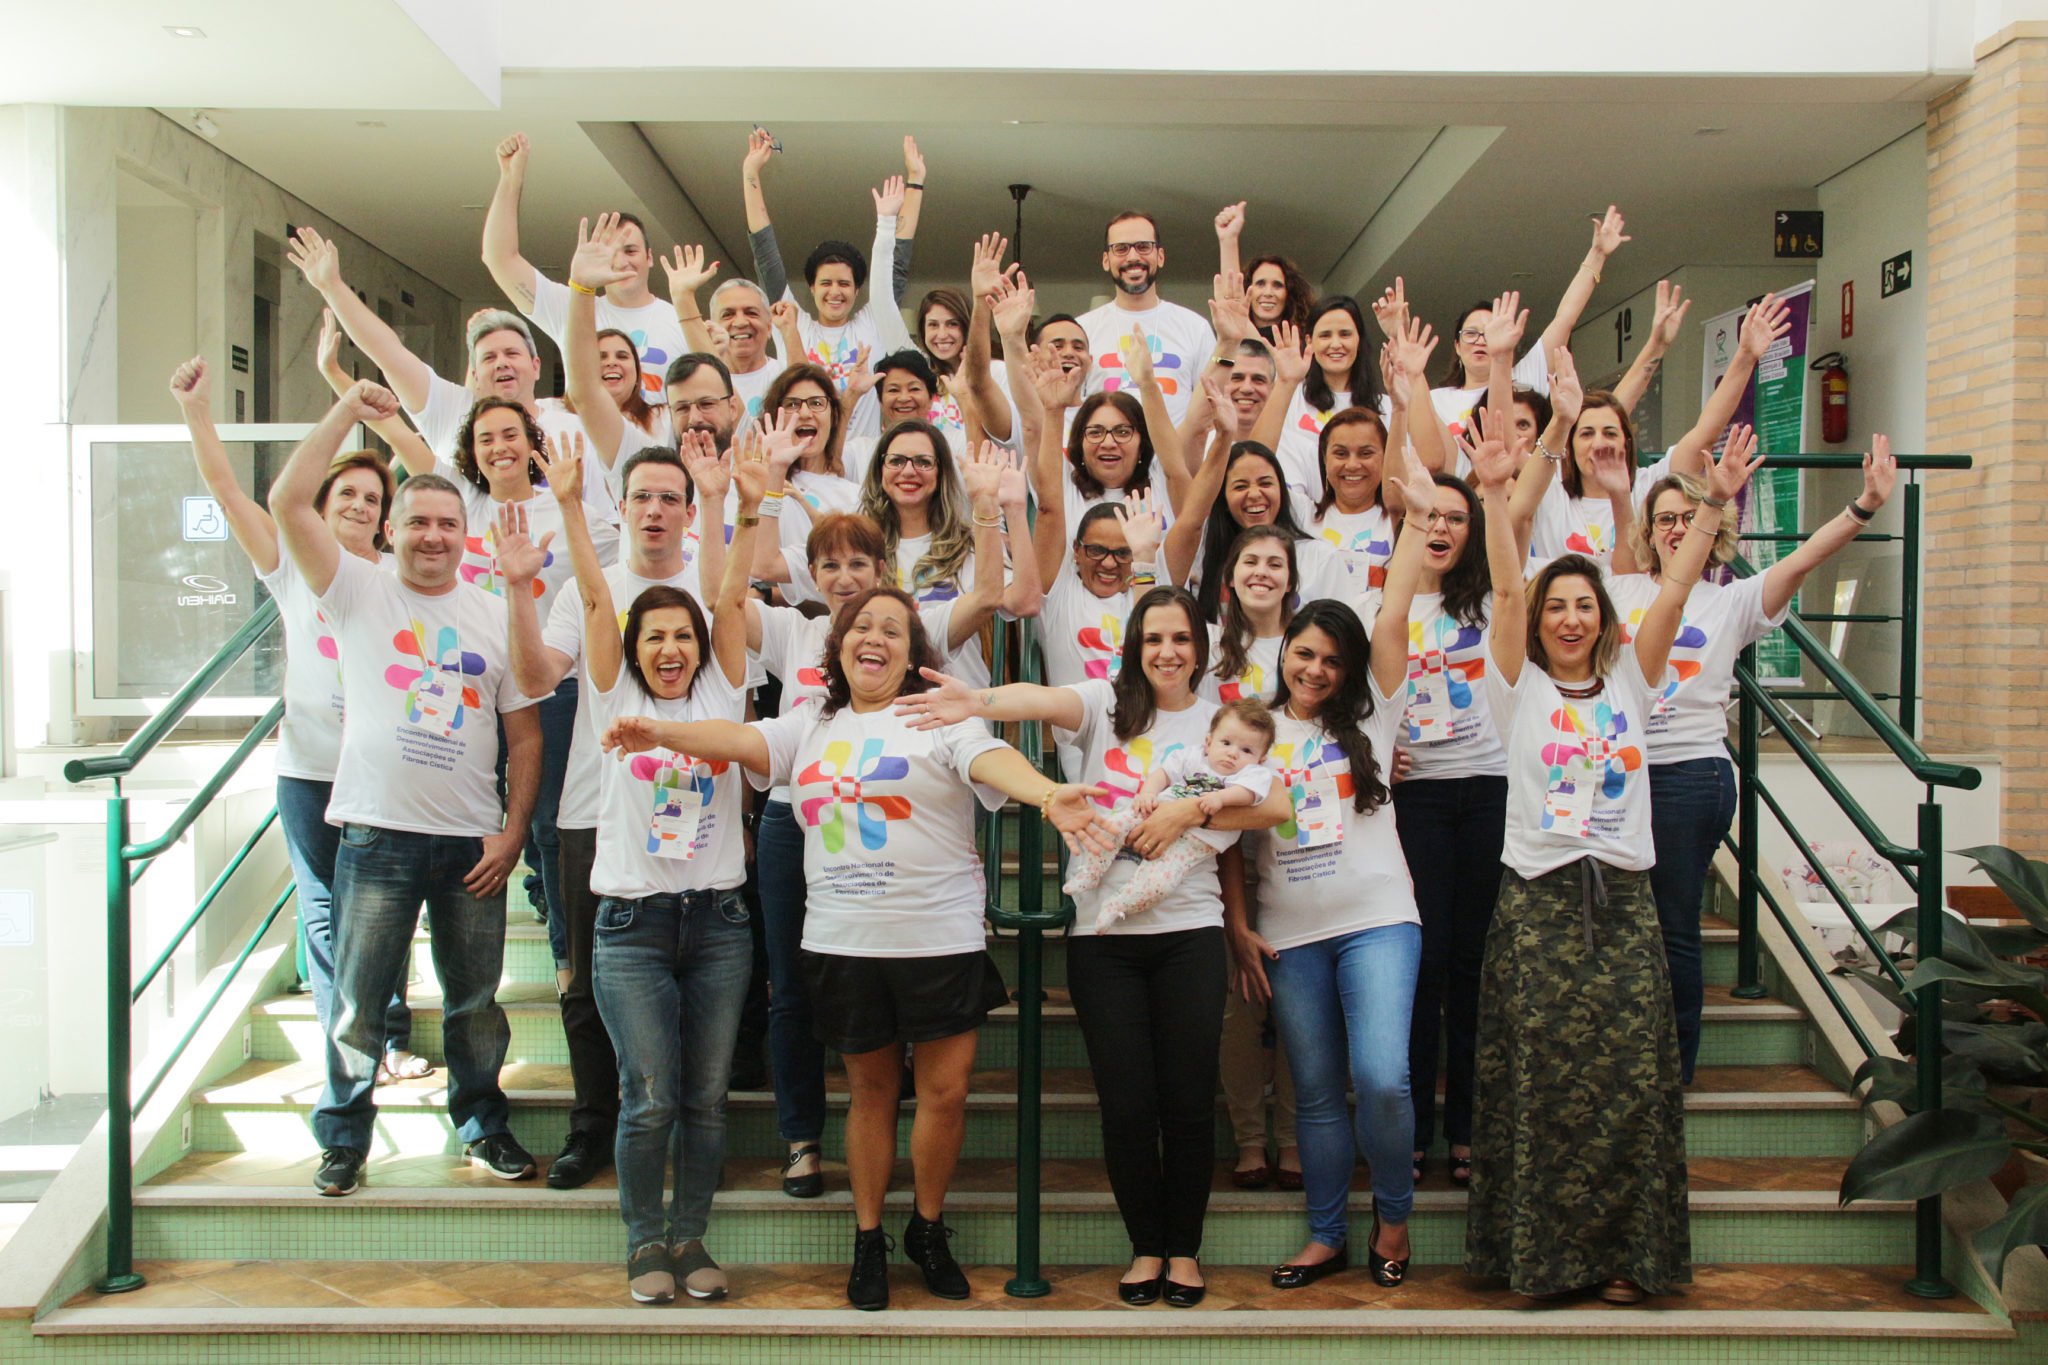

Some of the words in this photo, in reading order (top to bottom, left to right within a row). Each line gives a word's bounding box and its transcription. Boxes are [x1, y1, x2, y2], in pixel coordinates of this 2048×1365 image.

[397, 726, 428, 739] Encontro
[396, 735, 456, 754] Desenvolvimento
[402, 746, 446, 761] Associações
[1276, 848, 1304, 857] Encontro
